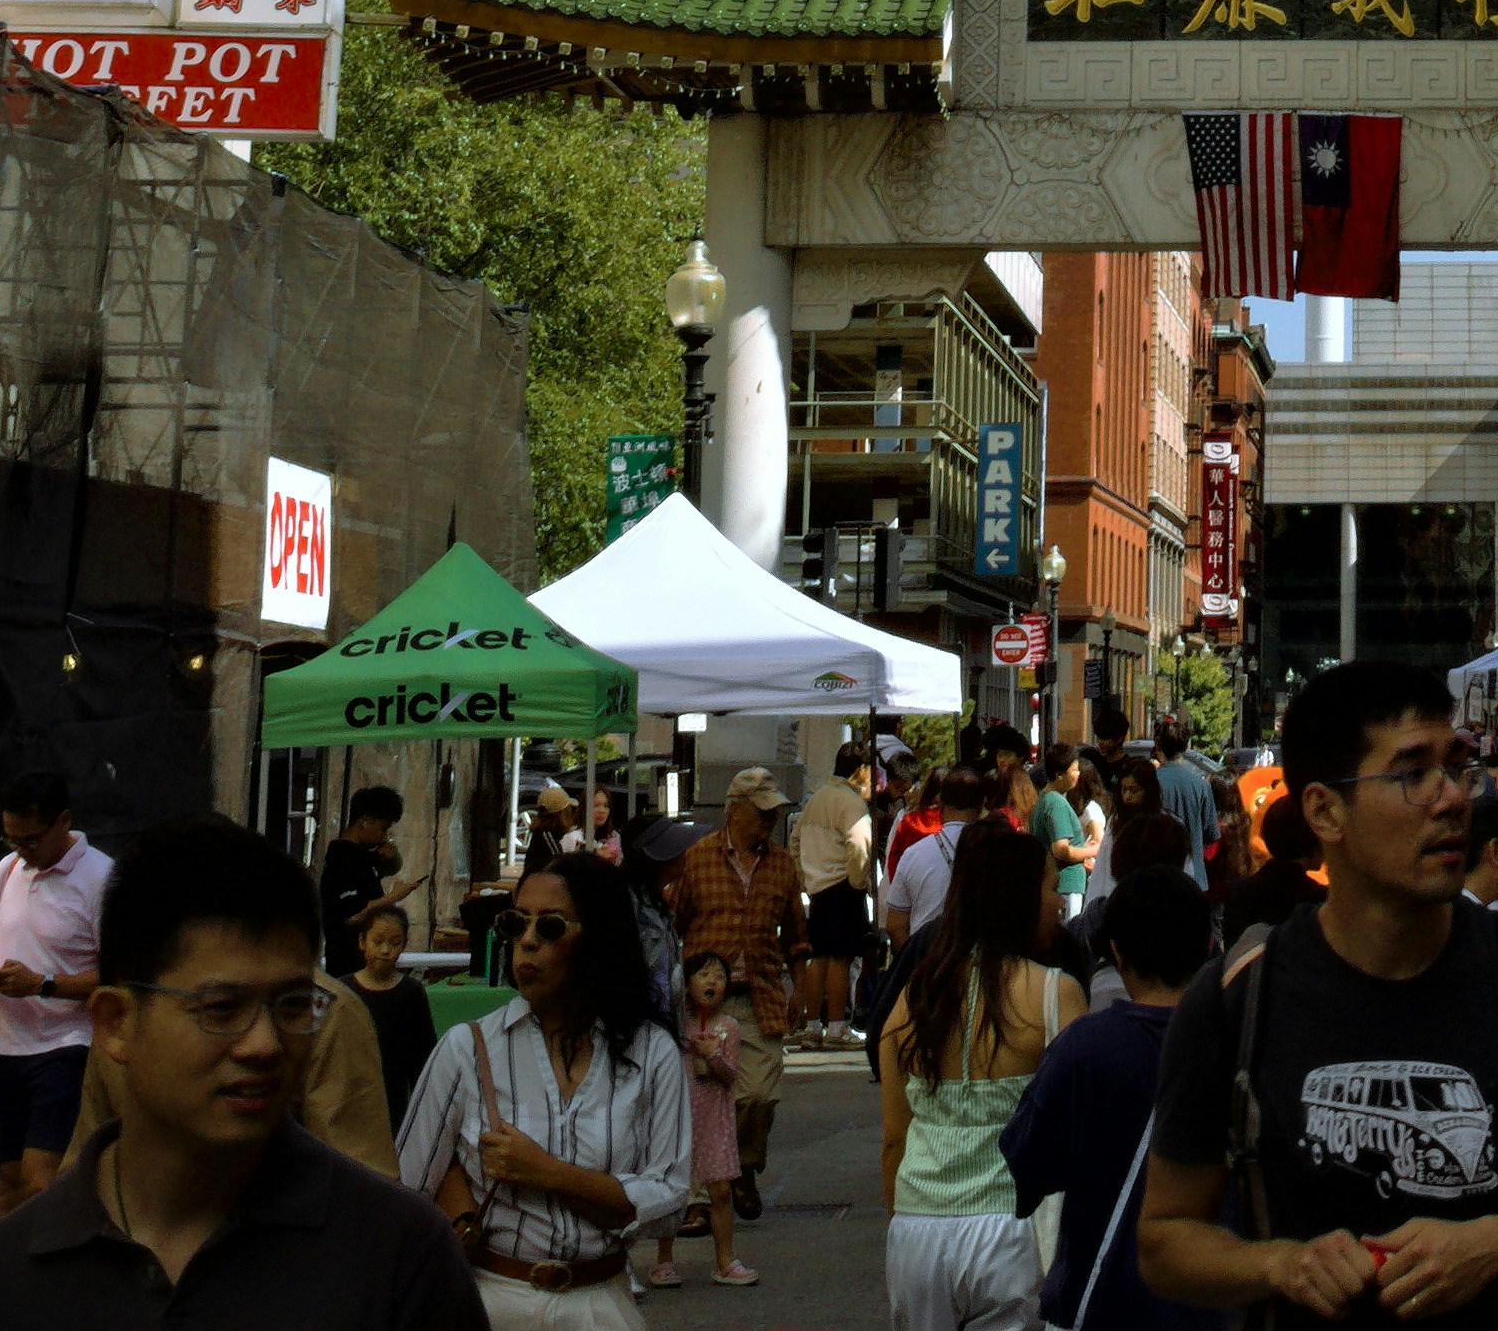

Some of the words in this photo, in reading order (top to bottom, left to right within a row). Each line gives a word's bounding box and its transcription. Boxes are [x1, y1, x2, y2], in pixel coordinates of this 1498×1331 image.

[164, 41, 297, 84] POT
[982, 430, 1014, 542] PARK
[270, 492, 325, 597] OPEN
[339, 621, 532, 657] cricket
[344, 682, 517, 729] cricket
